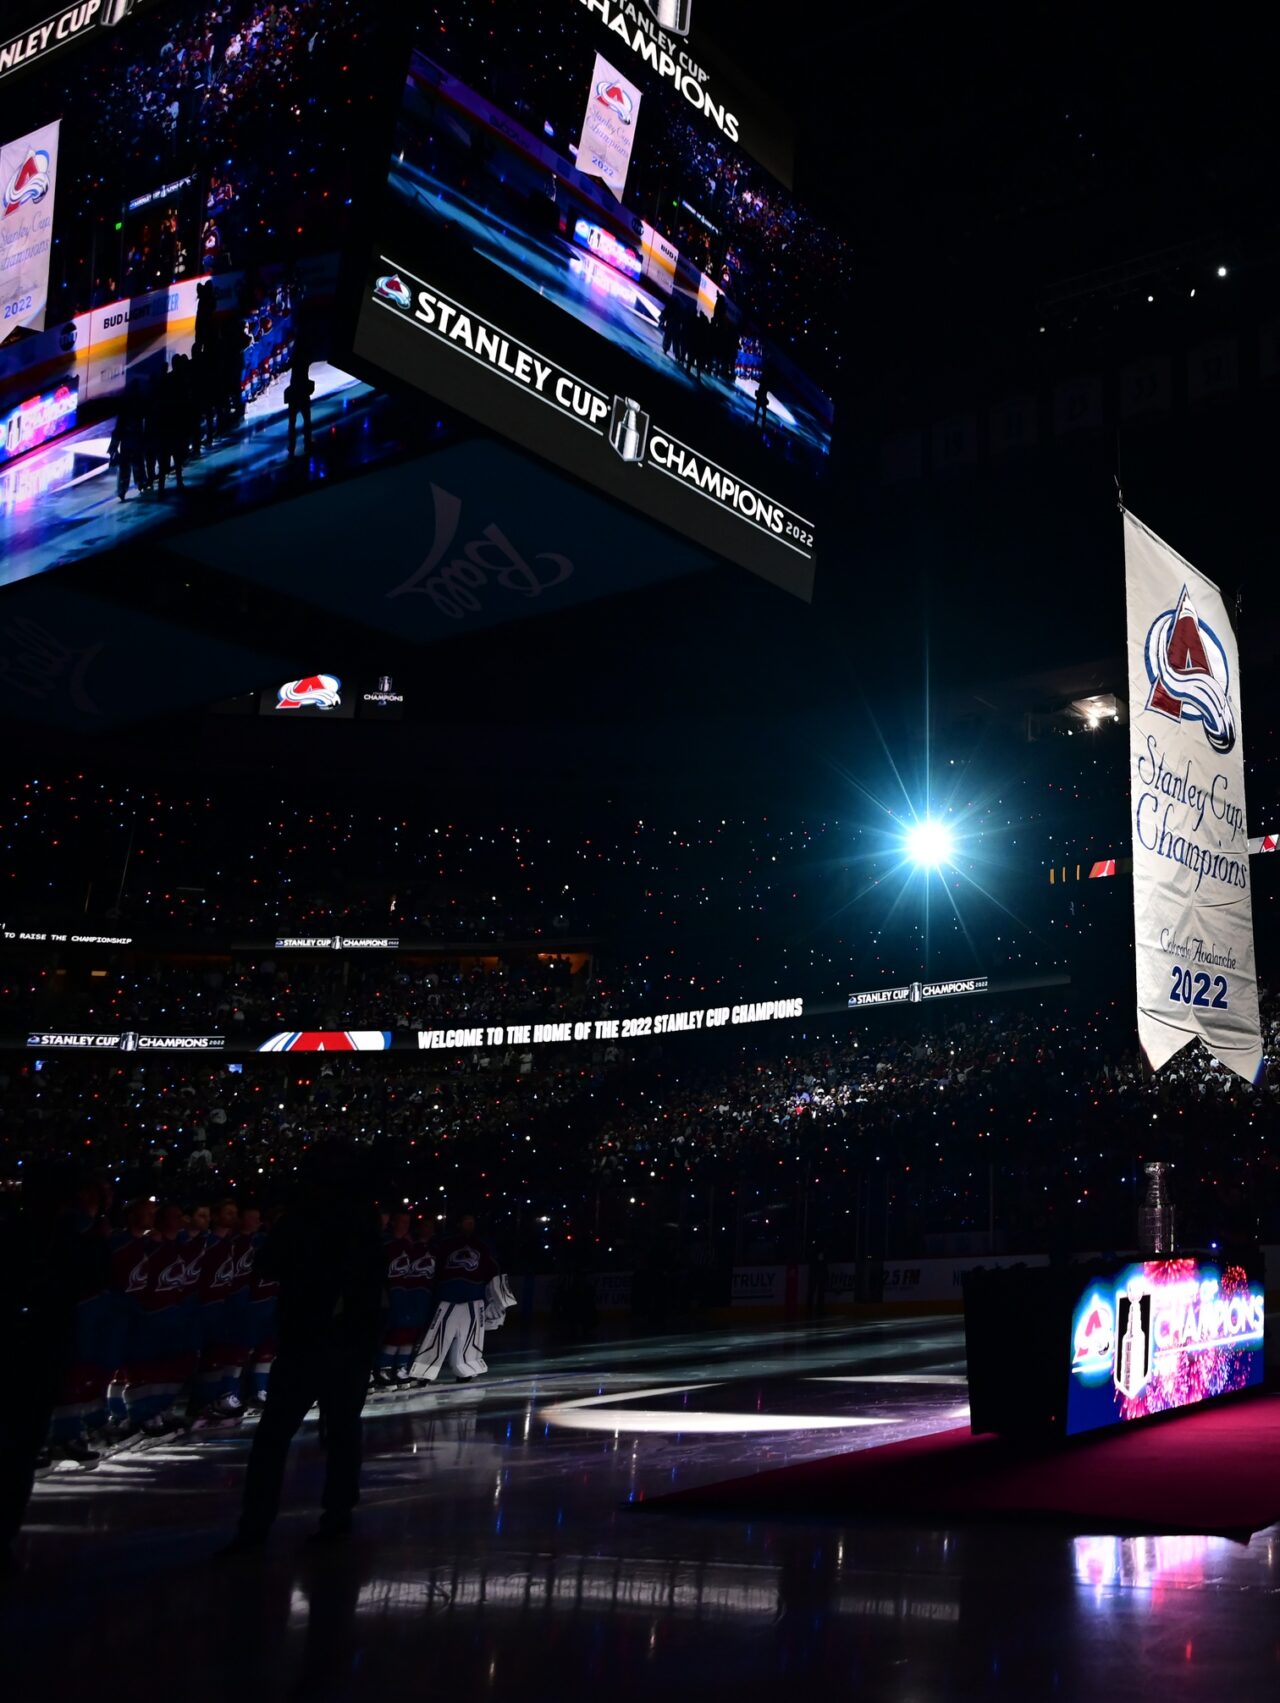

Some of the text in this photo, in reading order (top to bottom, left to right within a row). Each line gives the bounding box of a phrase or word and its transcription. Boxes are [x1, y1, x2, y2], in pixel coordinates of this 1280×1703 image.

[56, 0, 100, 40] CUP
[610, 0, 709, 82] TANLEY CUP
[579, 0, 740, 143] HAMPIONS
[591, 154, 614, 177] 2022
[4, 295, 32, 319] 2022
[103, 314, 124, 329] BUD
[414, 291, 610, 424] STANLEY CUP
[649, 435, 814, 548] CHAMPIONS 2022
[1138, 734, 1244, 842] Stanley Cup
[1136, 792, 1248, 892] Champions
[19, 933, 47, 941] RAISE
[51, 934, 67, 942] THE
[71, 935, 132, 944] CHAMPIONSHIP
[283, 938, 331, 947] STANLEY CUP
[342, 939, 388, 947] CHAMPIONS
[1192, 937, 1237, 970] Avalanche
[857, 989, 909, 1005] STANLEY CUP
[922, 980, 975, 997] CHAMPIONS
[1169, 964, 1229, 1010] 2022
[418, 997, 804, 1049] WELCOME TO THE HOME OF THE 2022 STANLEY CUP CHAMPIONS
[41, 1035, 120, 1046] STANLEY CUP
[138, 1037, 209, 1048] CHAMPIONS
[732, 1272, 775, 1289] TRULY
